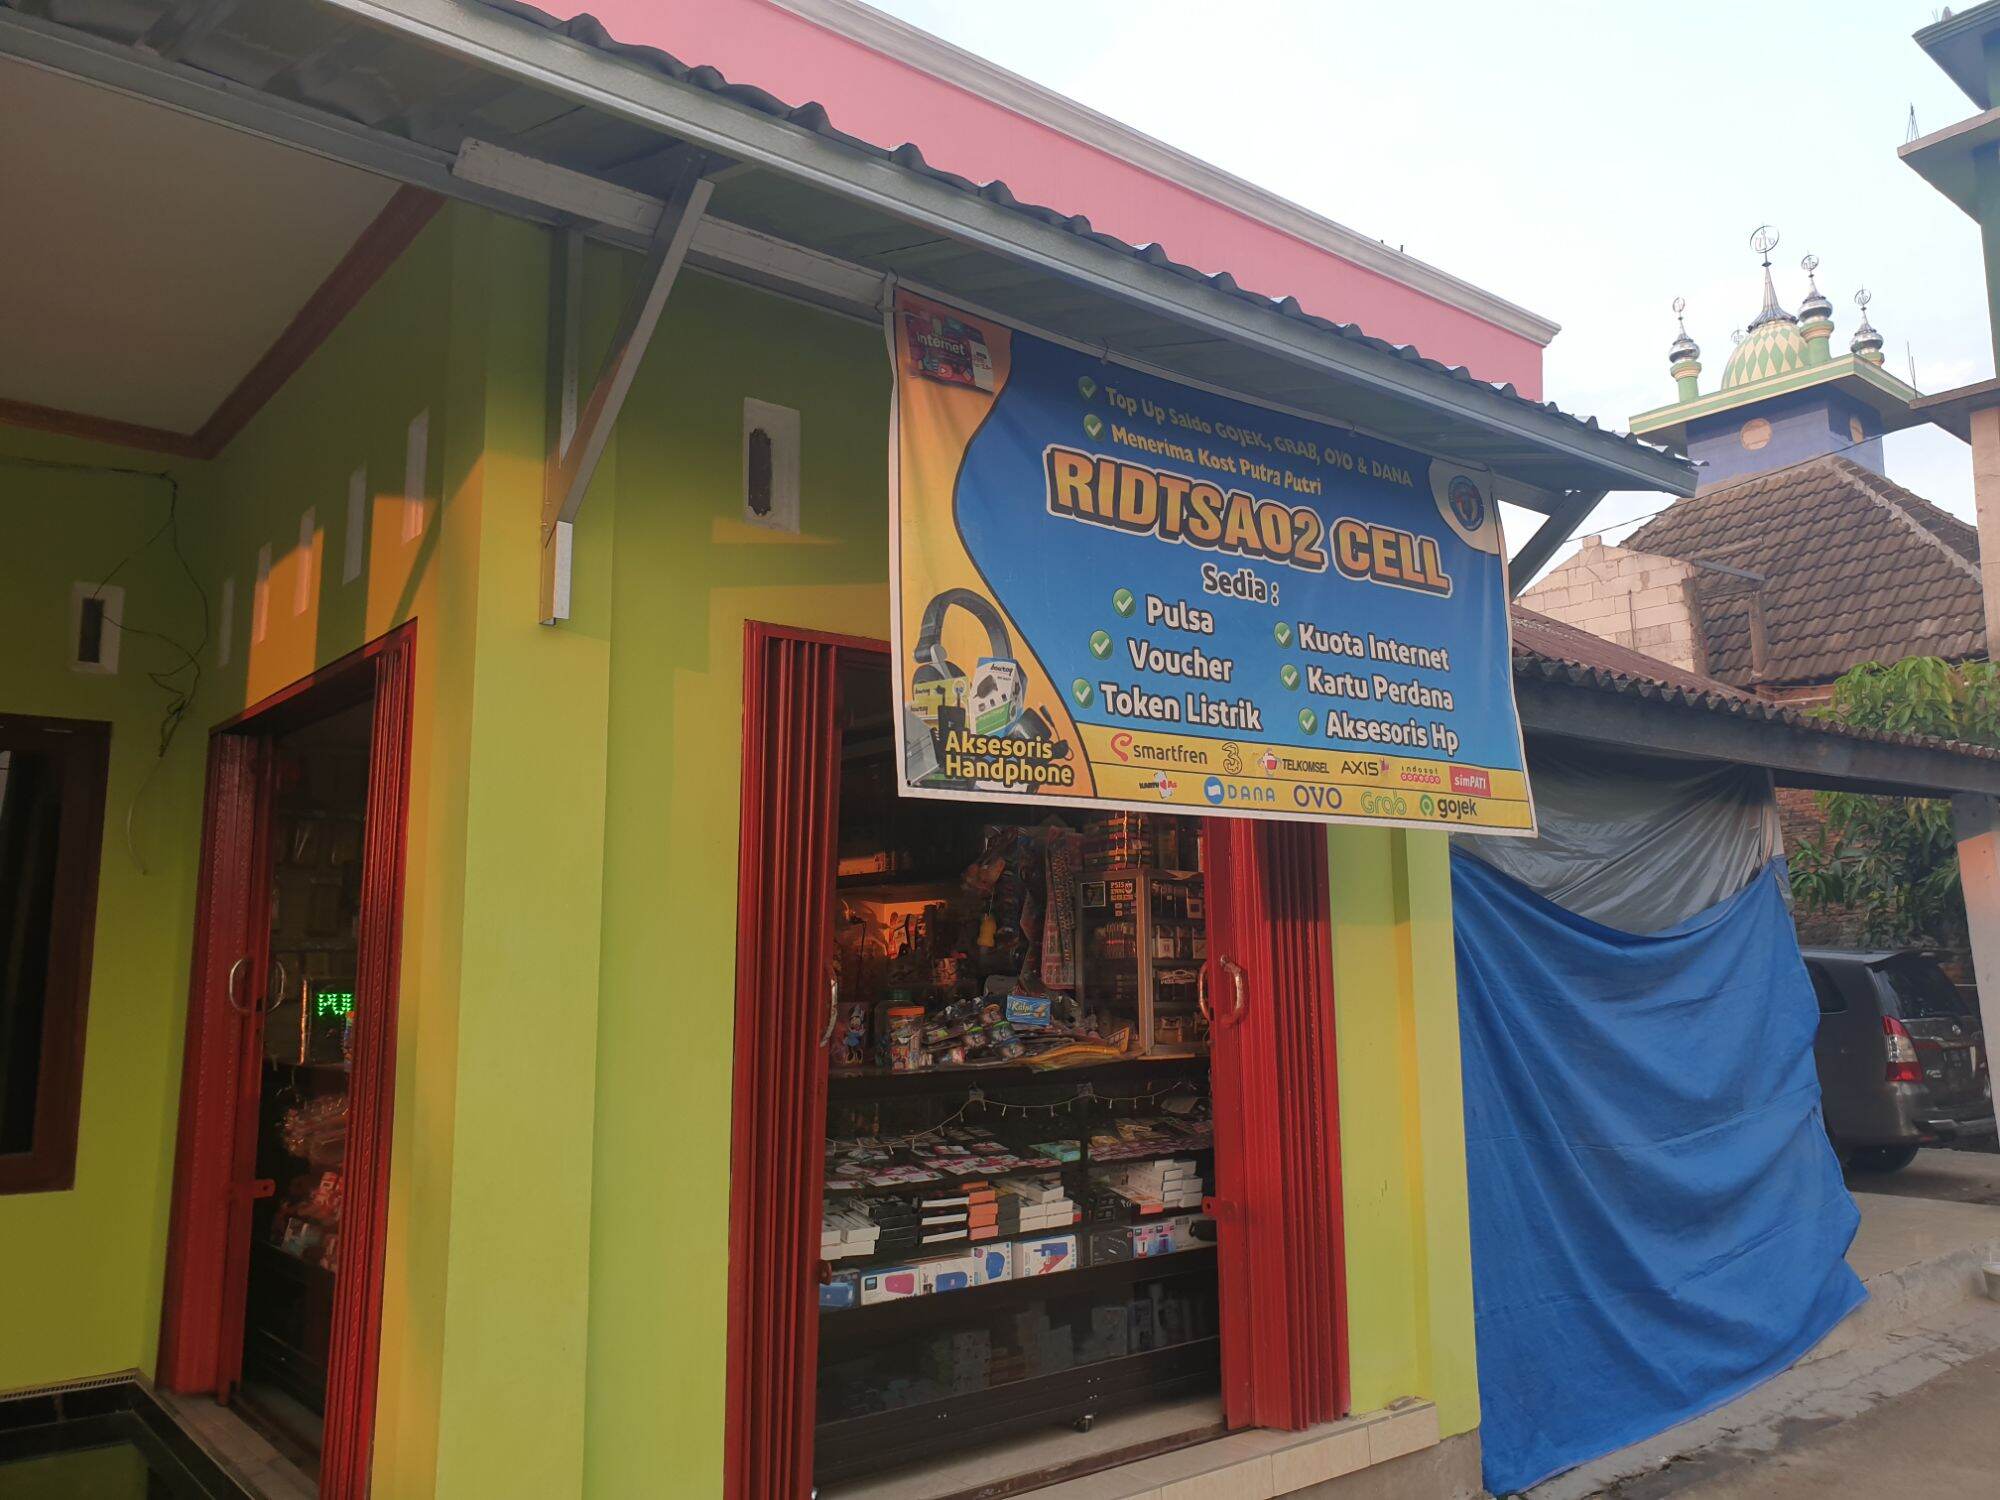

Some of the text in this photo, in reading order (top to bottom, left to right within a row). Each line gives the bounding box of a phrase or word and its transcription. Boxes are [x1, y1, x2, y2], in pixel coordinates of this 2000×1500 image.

[1105, 386, 1137, 416] Top
[1141, 399, 1166, 424] Up
[1168, 408, 1212, 435] Saldo
[1215, 421, 1273, 452] GOJEK,
[1273, 436, 1321, 466] GRAB,
[1357, 456, 1369, 475] &
[1371, 460, 1414, 488] DANA
[1110, 424, 1323, 496] Menerima Kost Putra Putri
[1330, 516, 1454, 598] CELL
[1201, 563, 1268, 603] Sedia
[1145, 594, 1215, 635] Pulsa
[1127, 637, 1233, 683] Voucher
[1297, 622, 1451, 671] Kuota Internet
[1305, 665, 1455, 712] Kartu Perdana
[1099, 682, 1264, 732] Token Listrik
[945, 729, 1054, 760] Aksesoris
[1325, 709, 1460, 757] Aksesoris Hp
[945, 753, 1074, 786] Handphone
[1133, 744, 1208, 765] smartfren
[1281, 758, 1330, 774] TELKOMSEL
[1340, 760, 1379, 777] AXIS
[1227, 784, 1276, 802] DANA
[1293, 784, 1343, 810] OVO
[1454, 774, 1486, 790] simPATI
[1360, 787, 1408, 816] Grab
[1437, 798, 1478, 820] gojek
